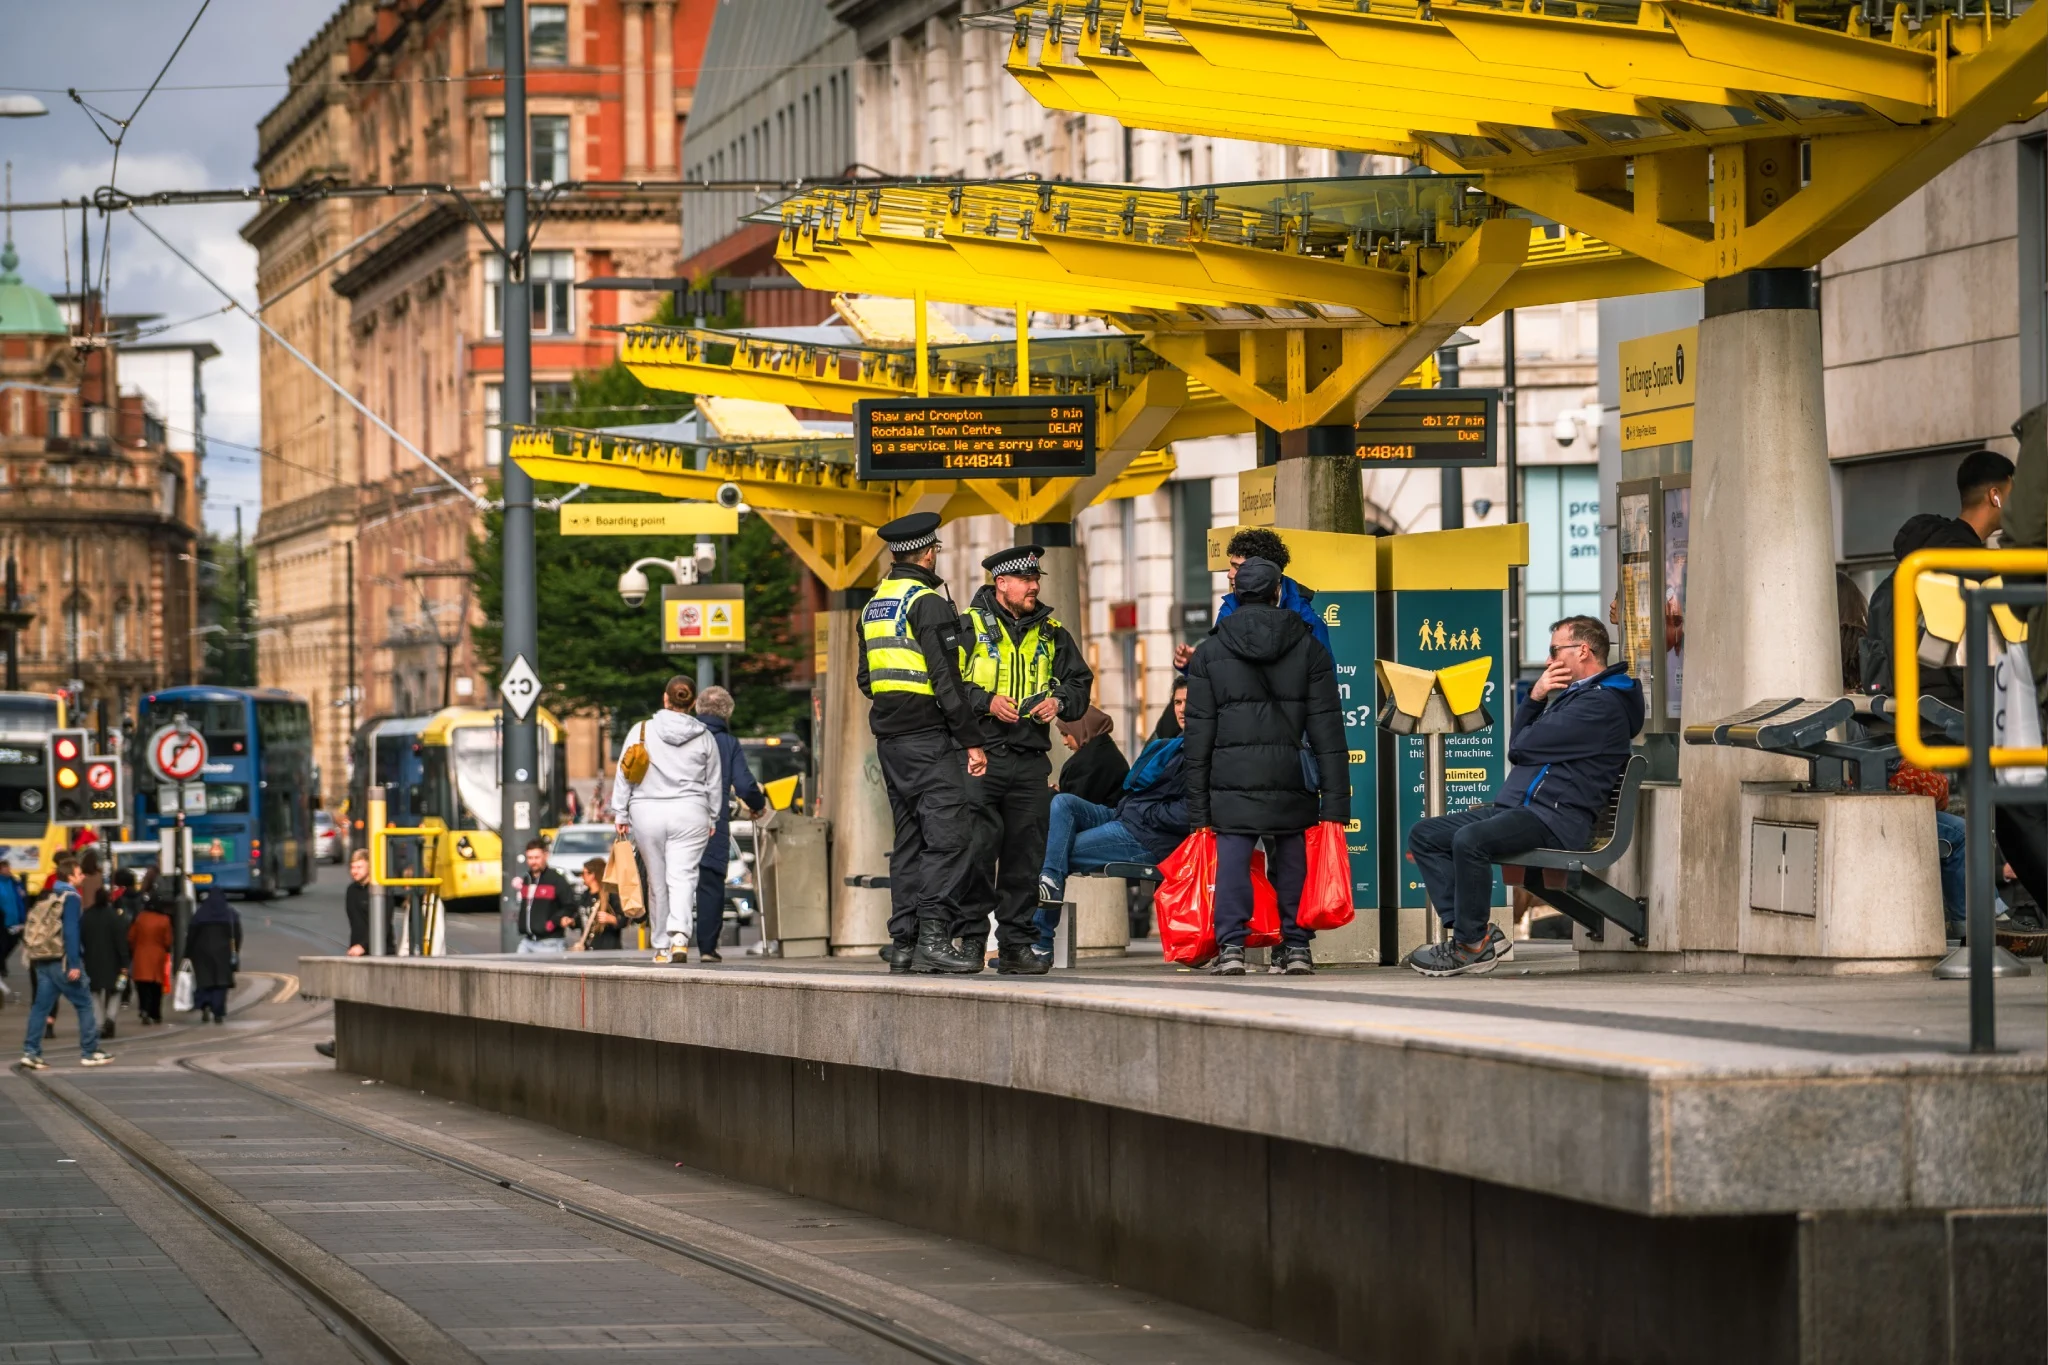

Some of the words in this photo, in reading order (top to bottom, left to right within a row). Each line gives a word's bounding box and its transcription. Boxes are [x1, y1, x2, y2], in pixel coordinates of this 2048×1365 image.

[1625, 365, 1652, 397] Exchange
[1653, 361, 1674, 395] Square
[871, 411, 898, 421] Shaw
[904, 411, 925, 421] and
[930, 410, 983, 422] Crompton
[1051, 408, 1058, 418] 8
[1063, 408, 1083, 418] min
[1447, 415, 1461, 426] 27
[1465, 416, 1485, 425] min
[872, 426, 925, 436] Rochdale
[930, 425, 957, 436] Town
[962, 424, 1002, 435] Centre
[1048, 423, 1083, 433] DELAY
[1458, 430, 1479, 441] Due
[888, 444, 895, 452] a
[900, 441, 950, 452] service.
[955, 440, 969, 450] We
[974, 441, 994, 450] are
[999, 440, 1034, 451] sorry
[1038, 439, 1058, 449] for
[1063, 439, 1084, 450] any
[945, 453, 1012, 468] 14:48:41
[1242, 491, 1258, 516] Exchange
[1259, 488, 1272, 514] Square
[596, 515, 639, 528] Boarding
[640, 516, 666, 527] point
[1570, 523, 1589, 538] to
[868, 607, 891, 620] POLICE
[1336, 663, 1358, 677] buy
[1482, 737, 1493, 745] on
[1454, 748, 1494, 758] machine.
[1451, 783, 1477, 792] travel
[1478, 783, 1491, 792] for
[1447, 796, 1453, 805] 2
[1455, 796, 1482, 805] adults
